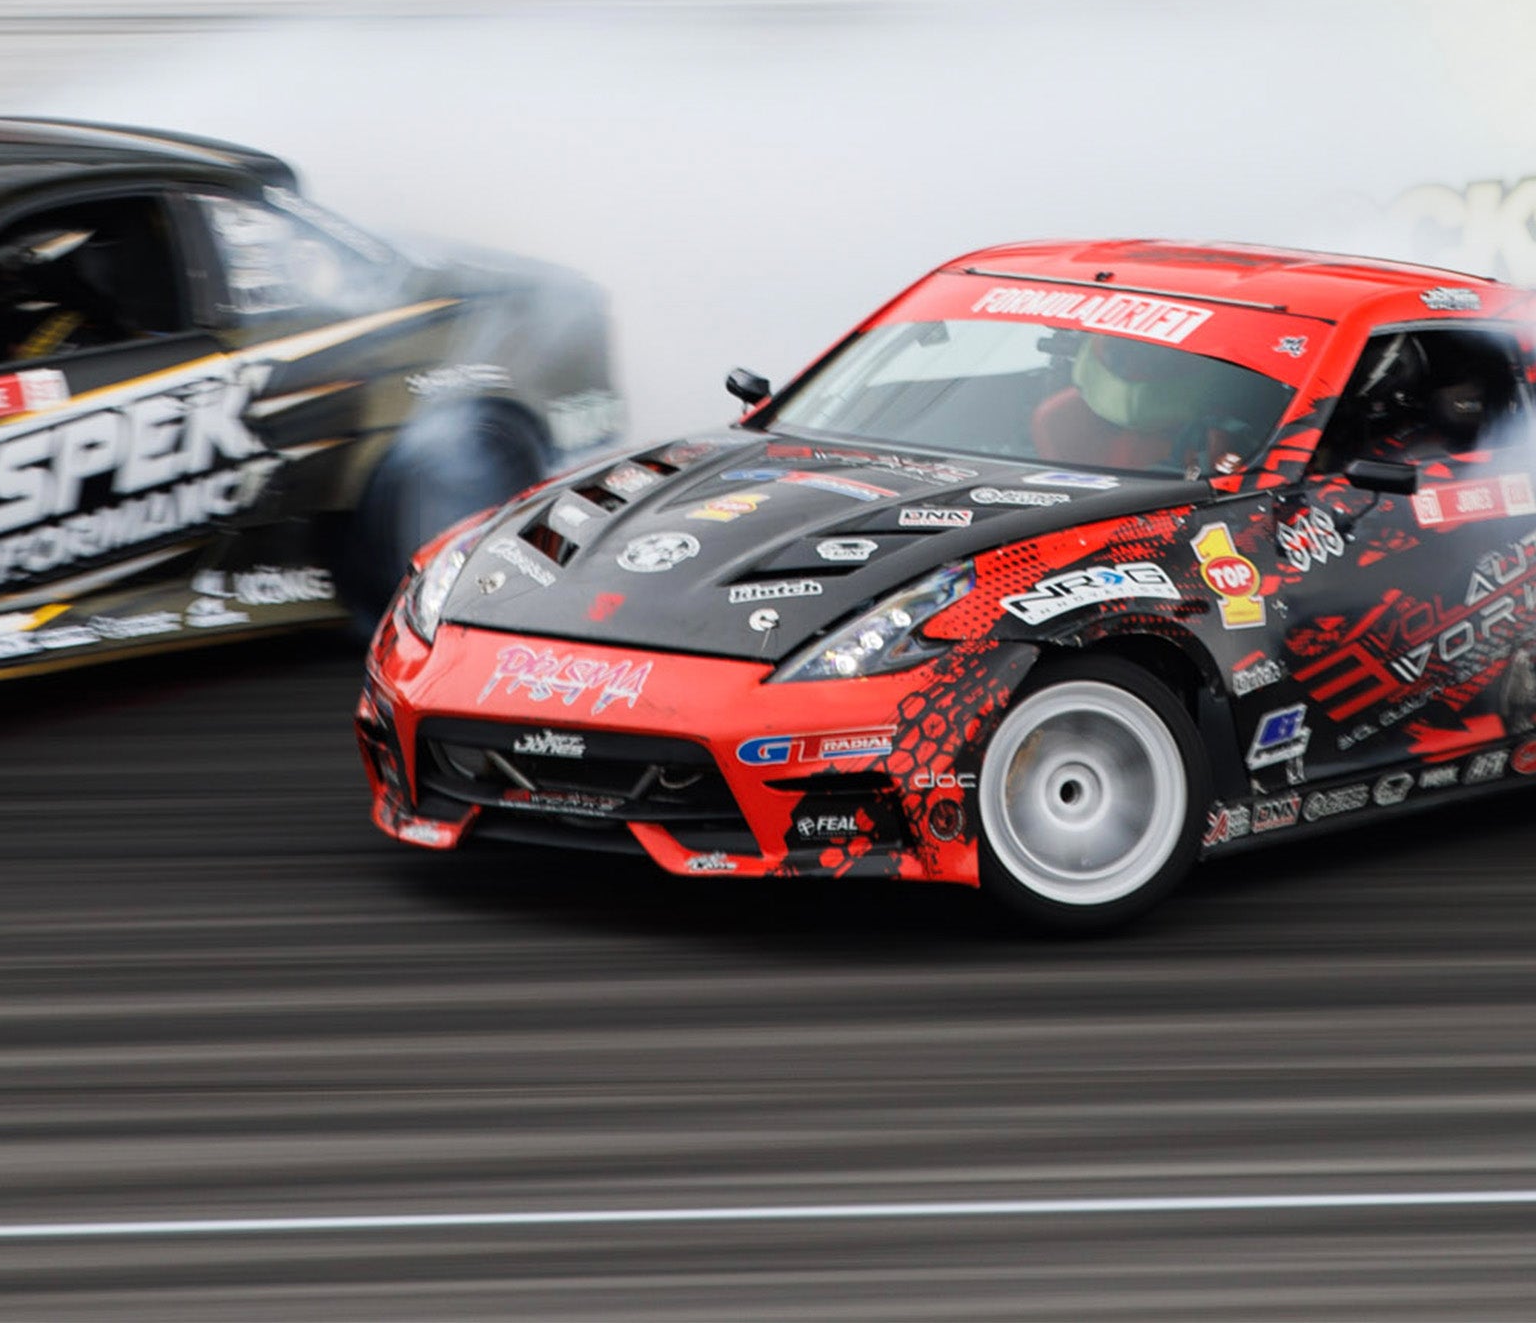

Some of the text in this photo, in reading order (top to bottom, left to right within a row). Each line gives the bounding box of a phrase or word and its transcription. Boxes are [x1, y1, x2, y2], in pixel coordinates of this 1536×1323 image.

[1208, 563, 1252, 589] TOP
[822, 736, 893, 753] RADIAL
[816, 815, 858, 832] FEAL
